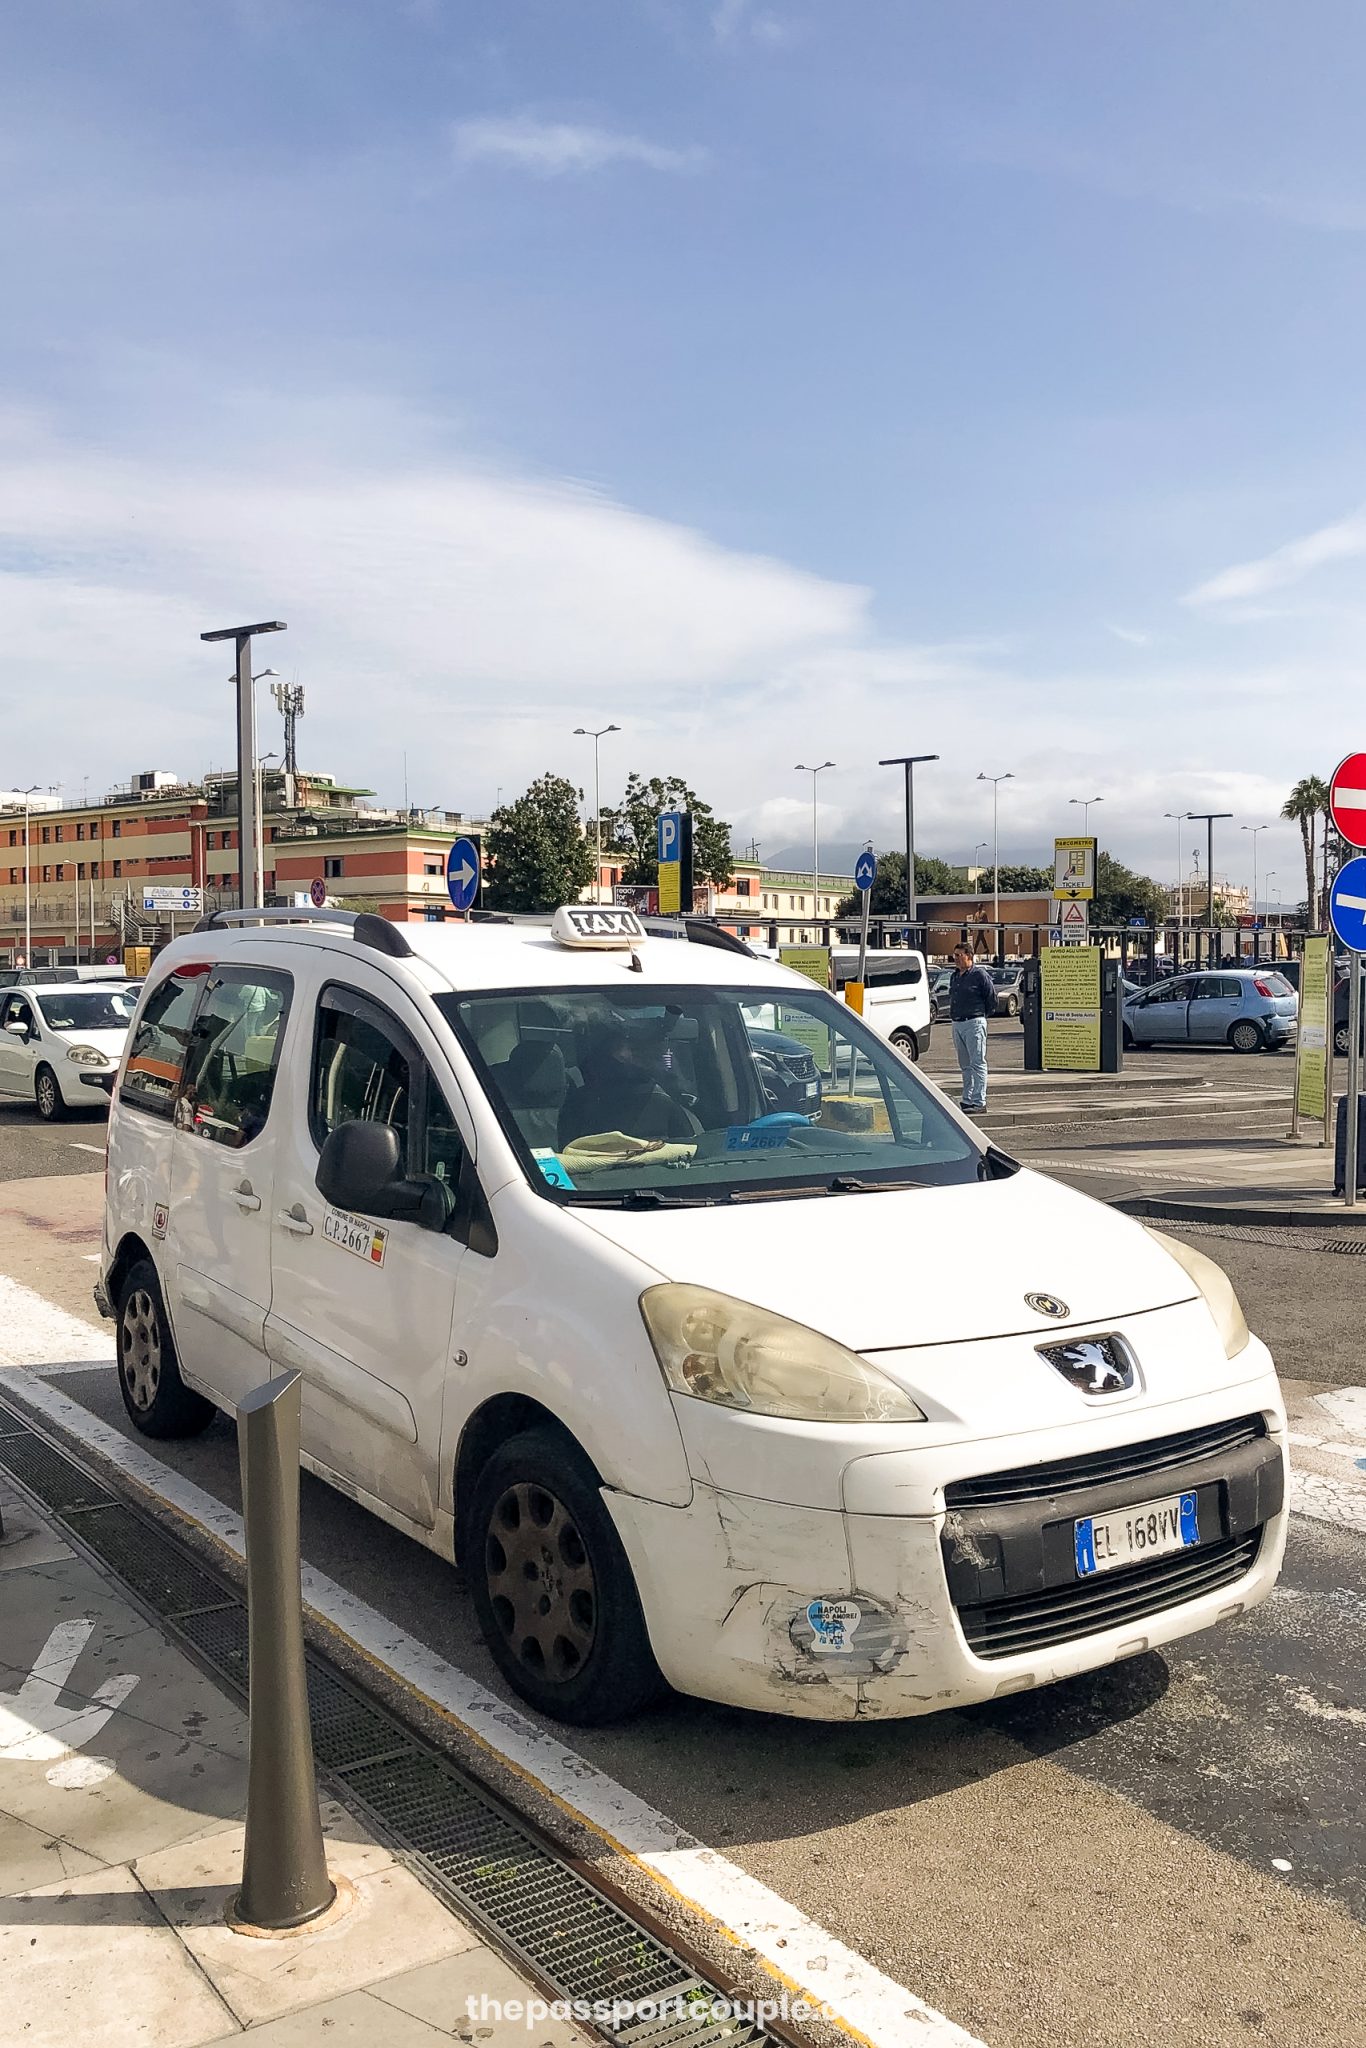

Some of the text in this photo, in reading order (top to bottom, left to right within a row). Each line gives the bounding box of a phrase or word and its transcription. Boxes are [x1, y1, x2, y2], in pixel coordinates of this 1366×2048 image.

[662, 819, 676, 858] P
[616, 888, 636, 896] ready
[571, 914, 637, 933] TAXI
[332, 1208, 348, 1221] COMUNE
[354, 1220, 370, 1231] NAPOLI
[1094, 1525, 1118, 1560] EL
[817, 1606, 847, 1614] NAPOLI
